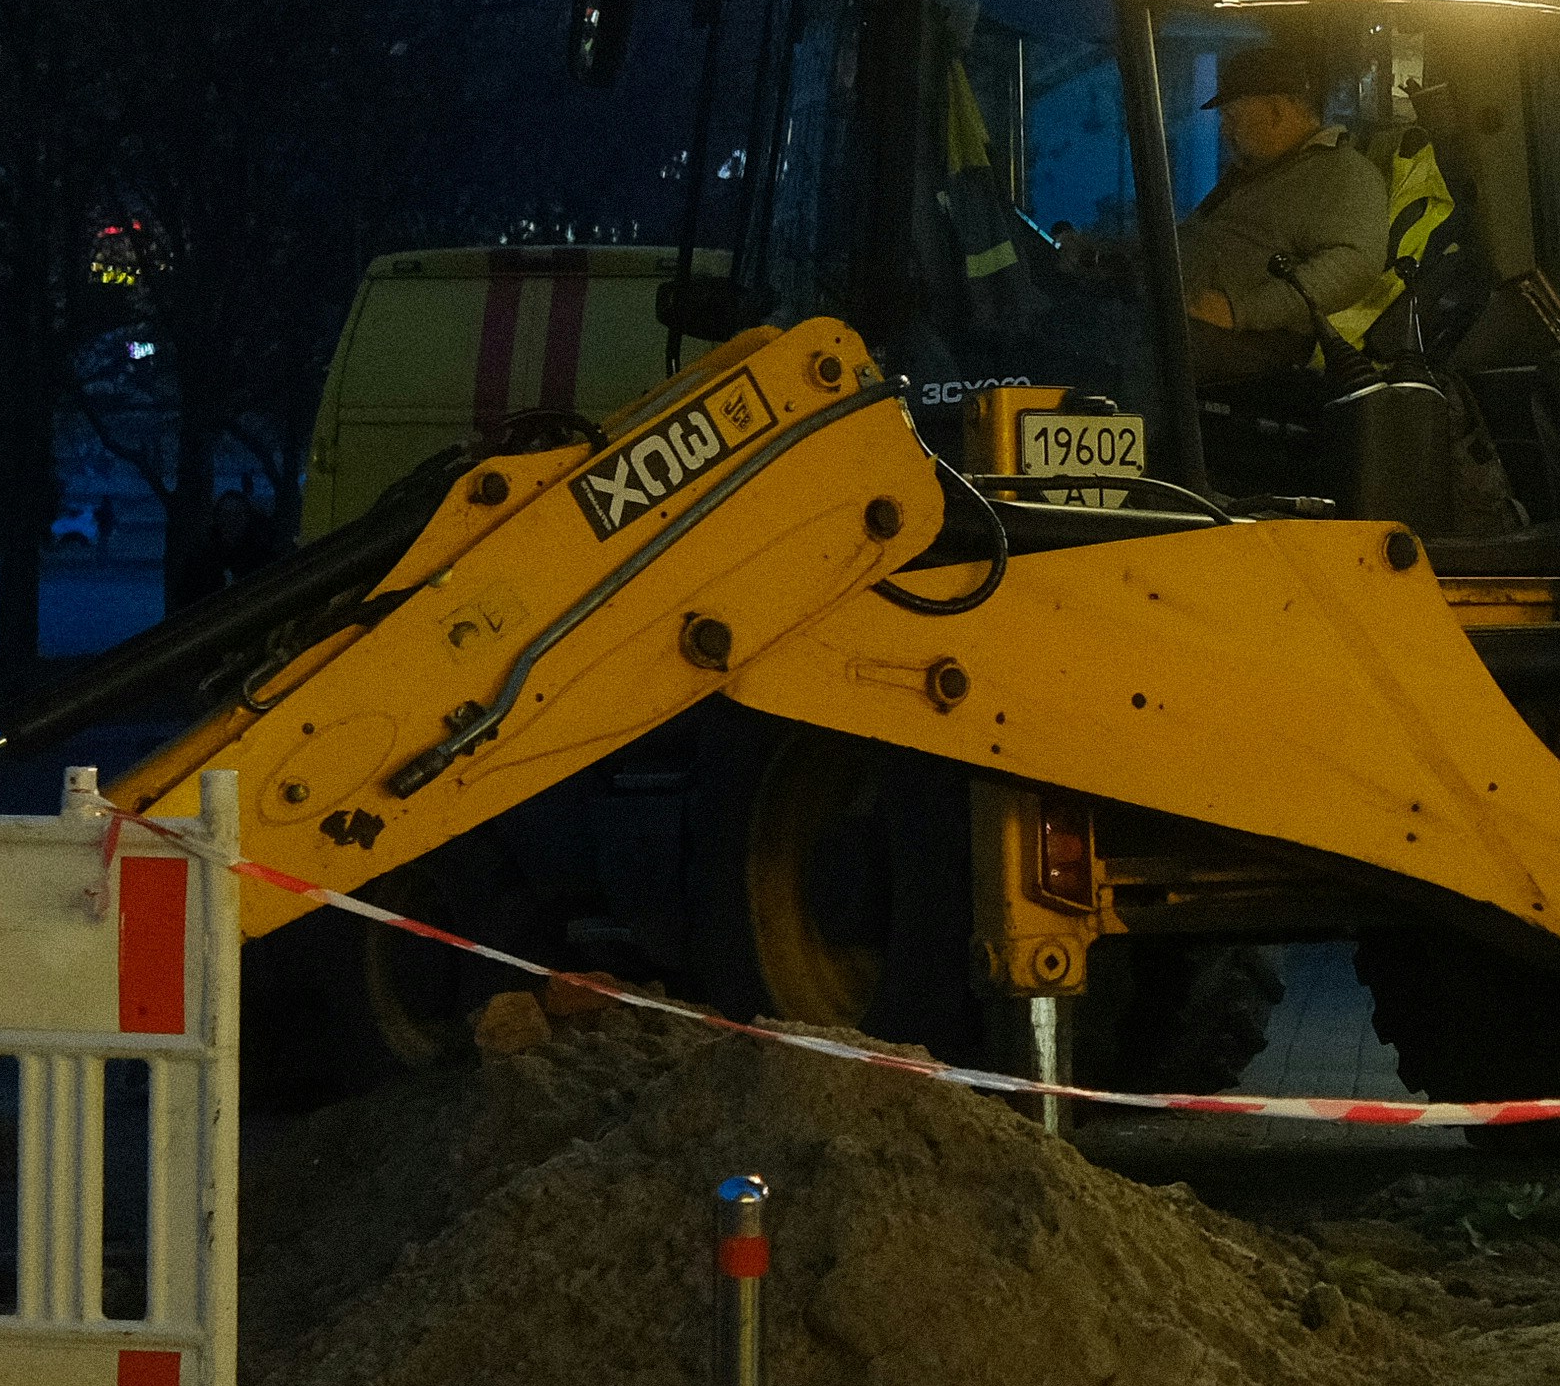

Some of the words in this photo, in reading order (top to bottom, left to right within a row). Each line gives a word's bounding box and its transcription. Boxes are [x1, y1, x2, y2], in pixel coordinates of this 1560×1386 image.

[722, 392, 754, 429] JCB
[1034, 426, 1138, 466] 19602
[586, 410, 721, 529] 3CX
